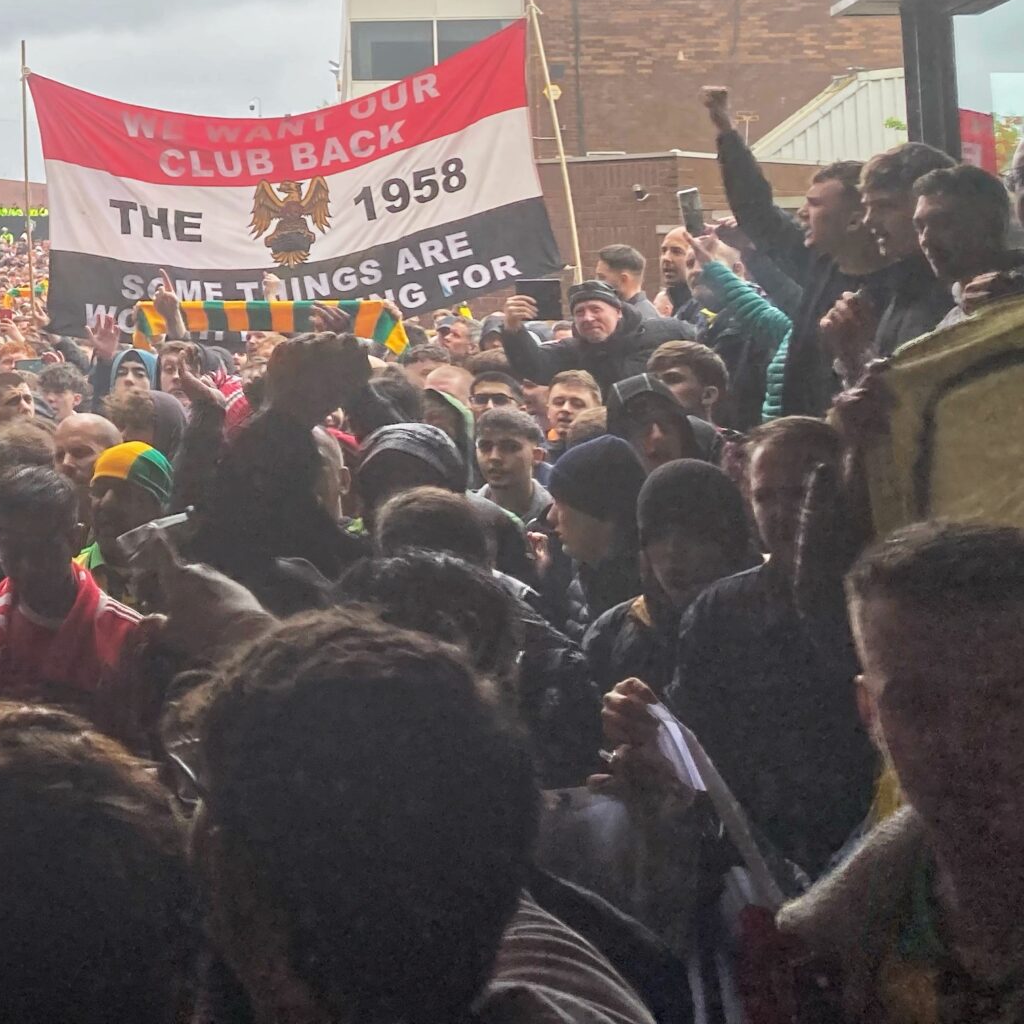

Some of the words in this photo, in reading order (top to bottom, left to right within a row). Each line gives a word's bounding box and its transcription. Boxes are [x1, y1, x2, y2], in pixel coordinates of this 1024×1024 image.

[122, 111, 183, 140] WE
[205, 111, 331, 143] WANT
[350, 73, 440, 119] OUR
[159, 148, 274, 177] CLUB
[290, 119, 406, 171] BACK
[109, 199, 203, 243] THE
[354, 157, 467, 222] 1958
[397, 231, 474, 275] ARE
[438, 254, 523, 298] FOR
